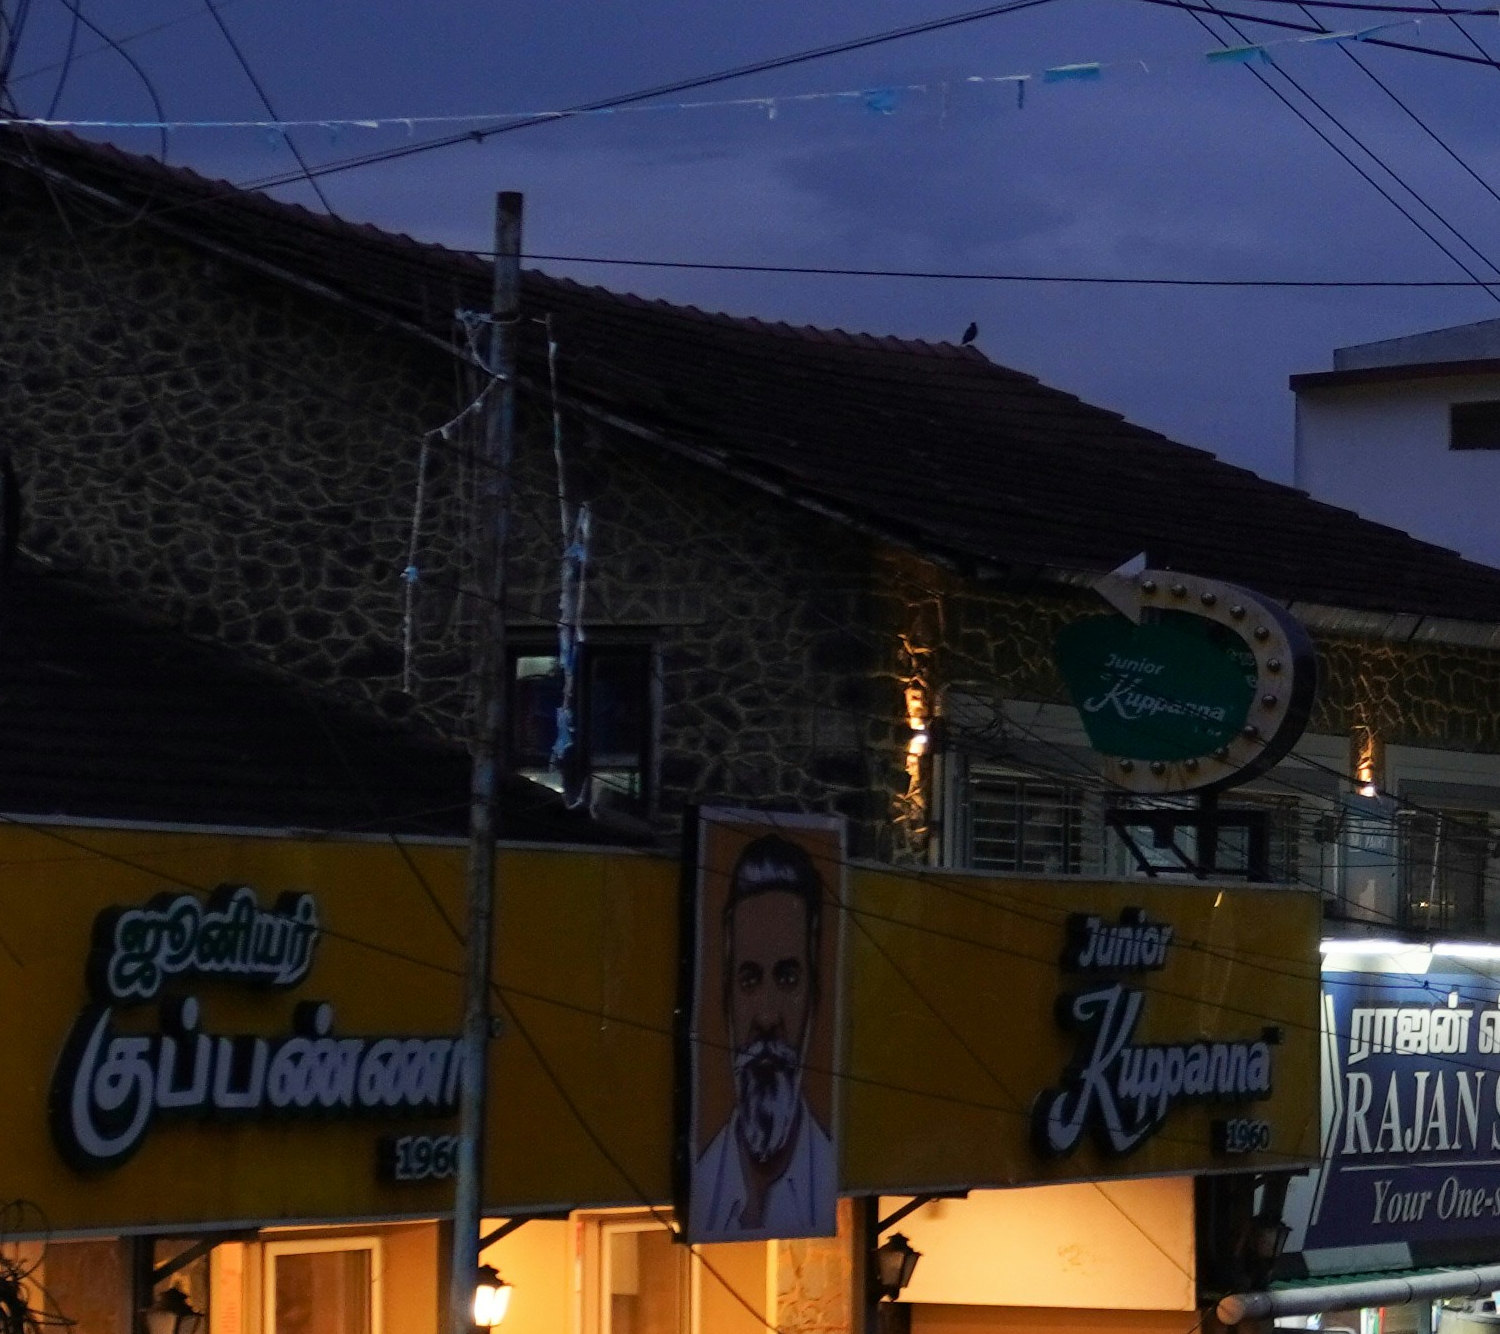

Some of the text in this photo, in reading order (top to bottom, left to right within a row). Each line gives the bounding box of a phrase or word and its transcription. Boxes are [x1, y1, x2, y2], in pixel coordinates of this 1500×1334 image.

[1079, 909, 1173, 967] Junior
[1348, 991, 1473, 1065] ராஜன்
[1048, 982, 1271, 1152] Kuppanna
[1226, 1119, 1270, 1152] 1960
[1341, 1071, 1485, 1155] RAJAN
[1372, 1180, 1432, 1225] Your
